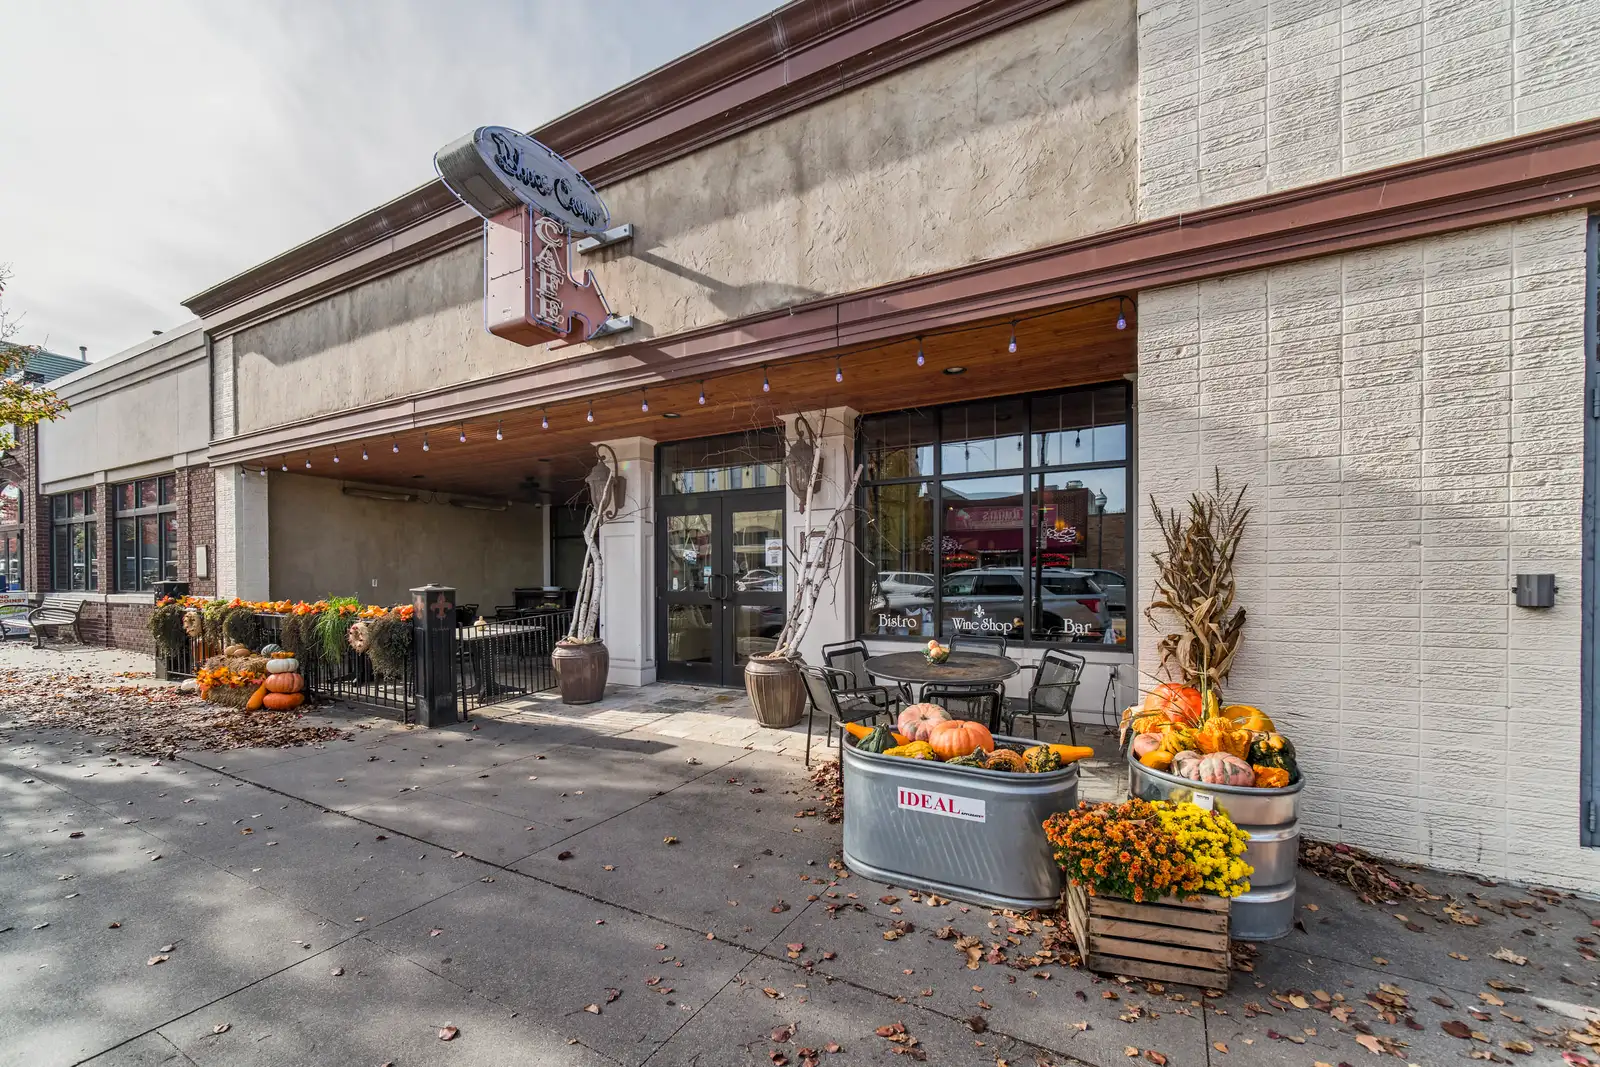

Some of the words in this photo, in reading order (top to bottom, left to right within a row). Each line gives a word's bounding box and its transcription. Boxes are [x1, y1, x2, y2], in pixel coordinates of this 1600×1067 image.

[878, 613, 917, 628] Bistro
[952, 617, 980, 630] Wine
[980, 617, 1013, 636] Shop
[1063, 618, 1092, 634] Bar
[900, 790, 961, 814] IDEAL
